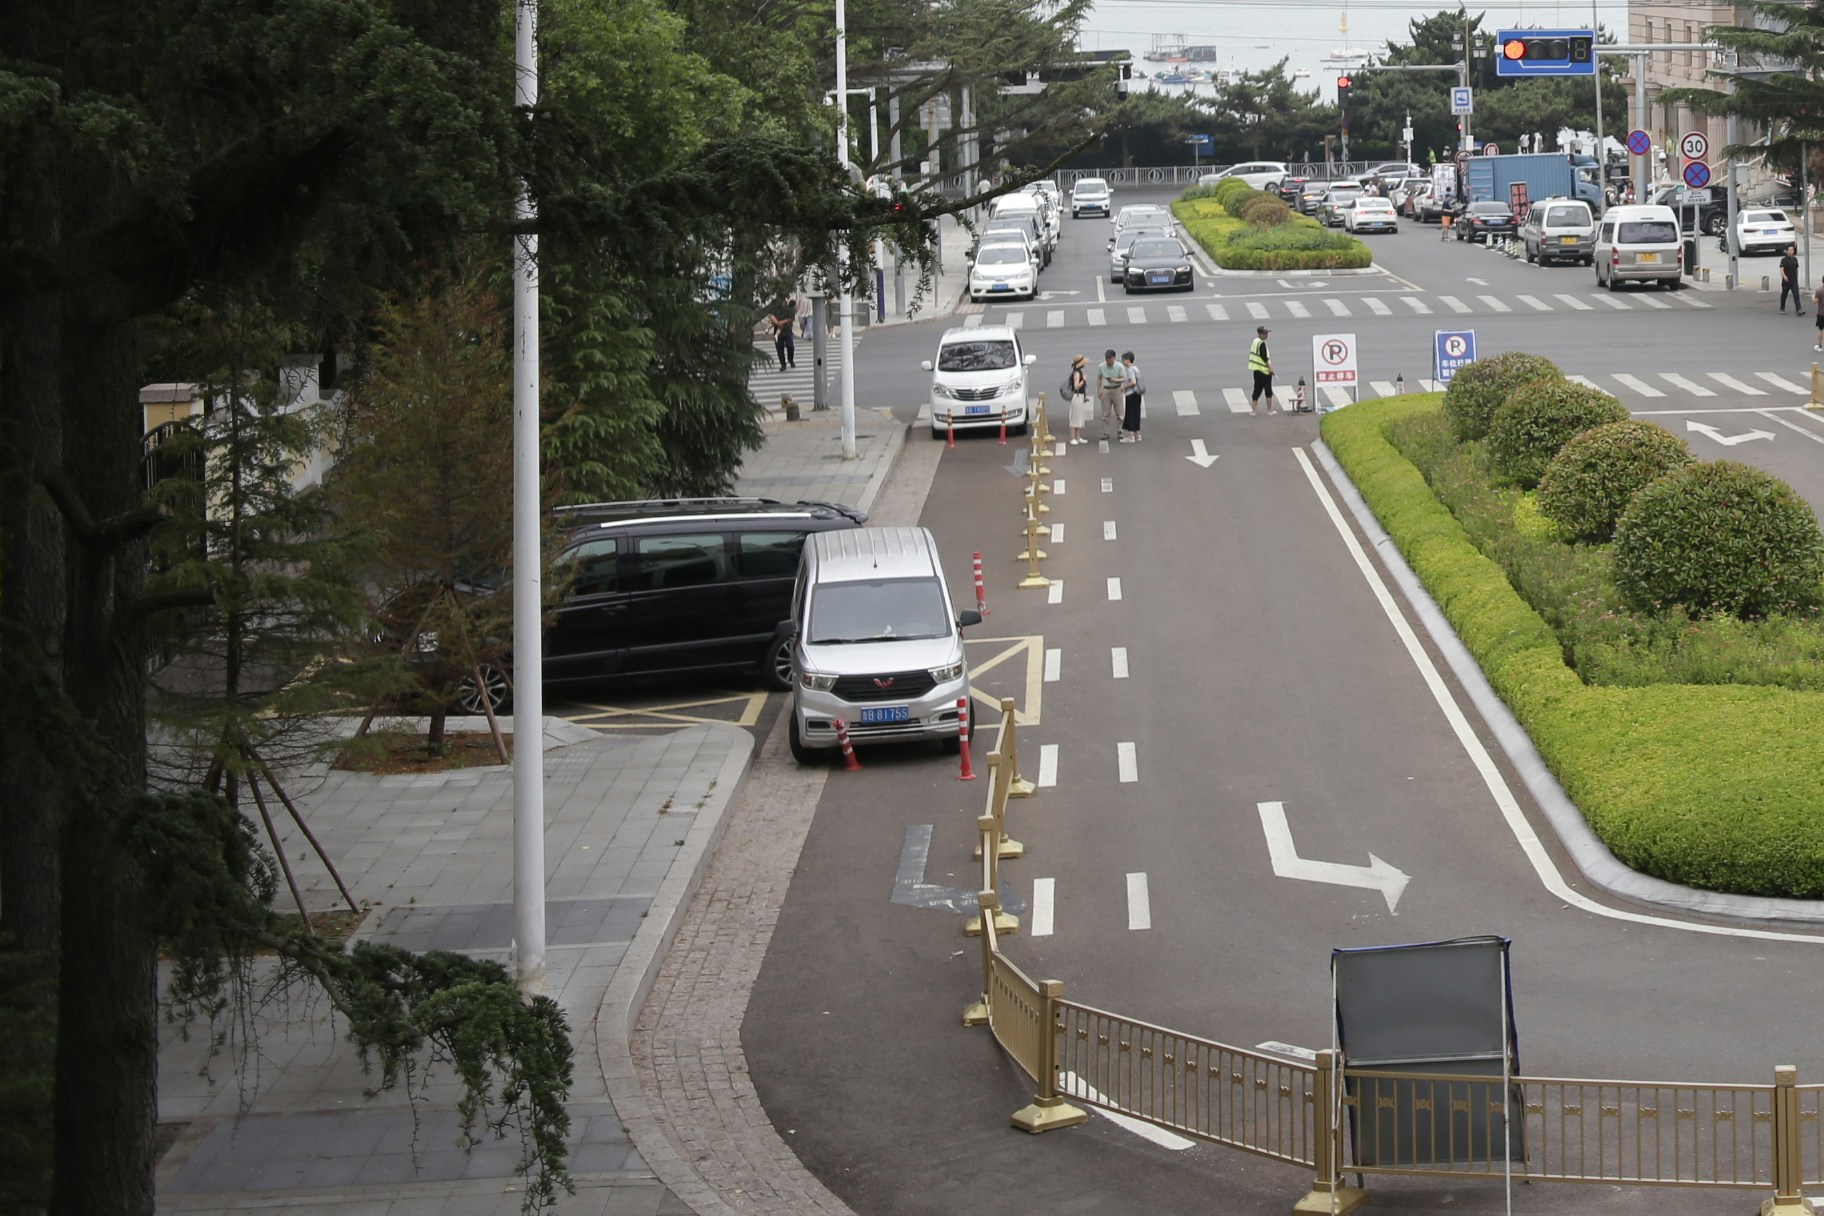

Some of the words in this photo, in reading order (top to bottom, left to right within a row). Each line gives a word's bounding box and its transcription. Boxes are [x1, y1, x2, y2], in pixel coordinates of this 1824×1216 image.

[1686, 140, 1703, 153] 30
[1318, 371, 1354, 381] 禁止停车
